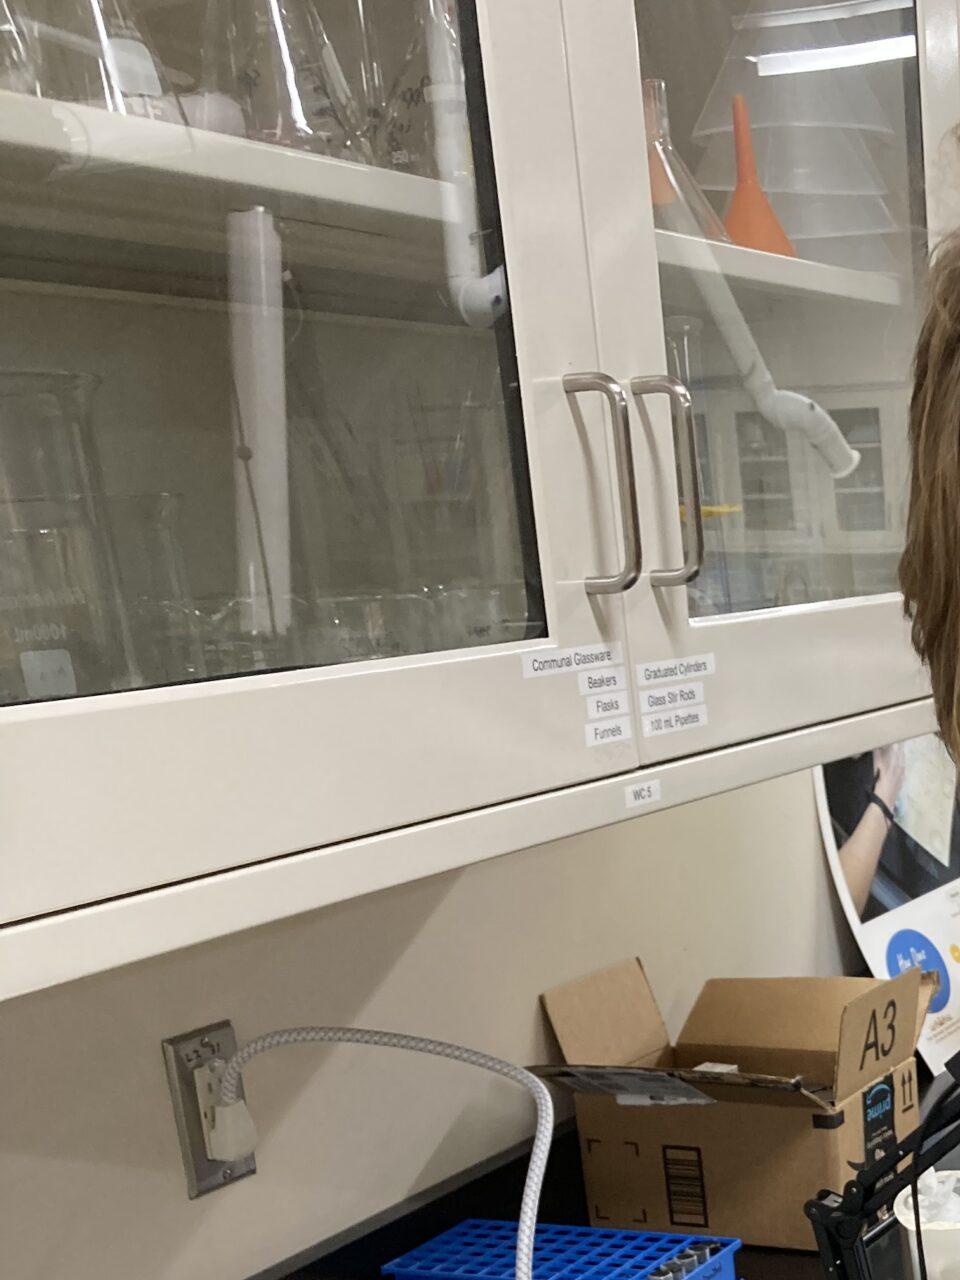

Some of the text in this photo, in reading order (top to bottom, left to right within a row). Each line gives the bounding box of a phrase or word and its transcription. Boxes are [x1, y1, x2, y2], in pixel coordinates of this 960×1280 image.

[532, 649, 612, 672] Communal Glassware
[644, 660, 708, 681] Graduated Cylinders
[587, 674, 617, 689] Beakers
[596, 699, 620, 713] Flasks
[647, 687, 696, 708] Glass Stir Rods
[675, 711, 700, 727] Pipettes
[594, 723, 622, 740] Funnels
[859, 998, 897, 1071] A3
